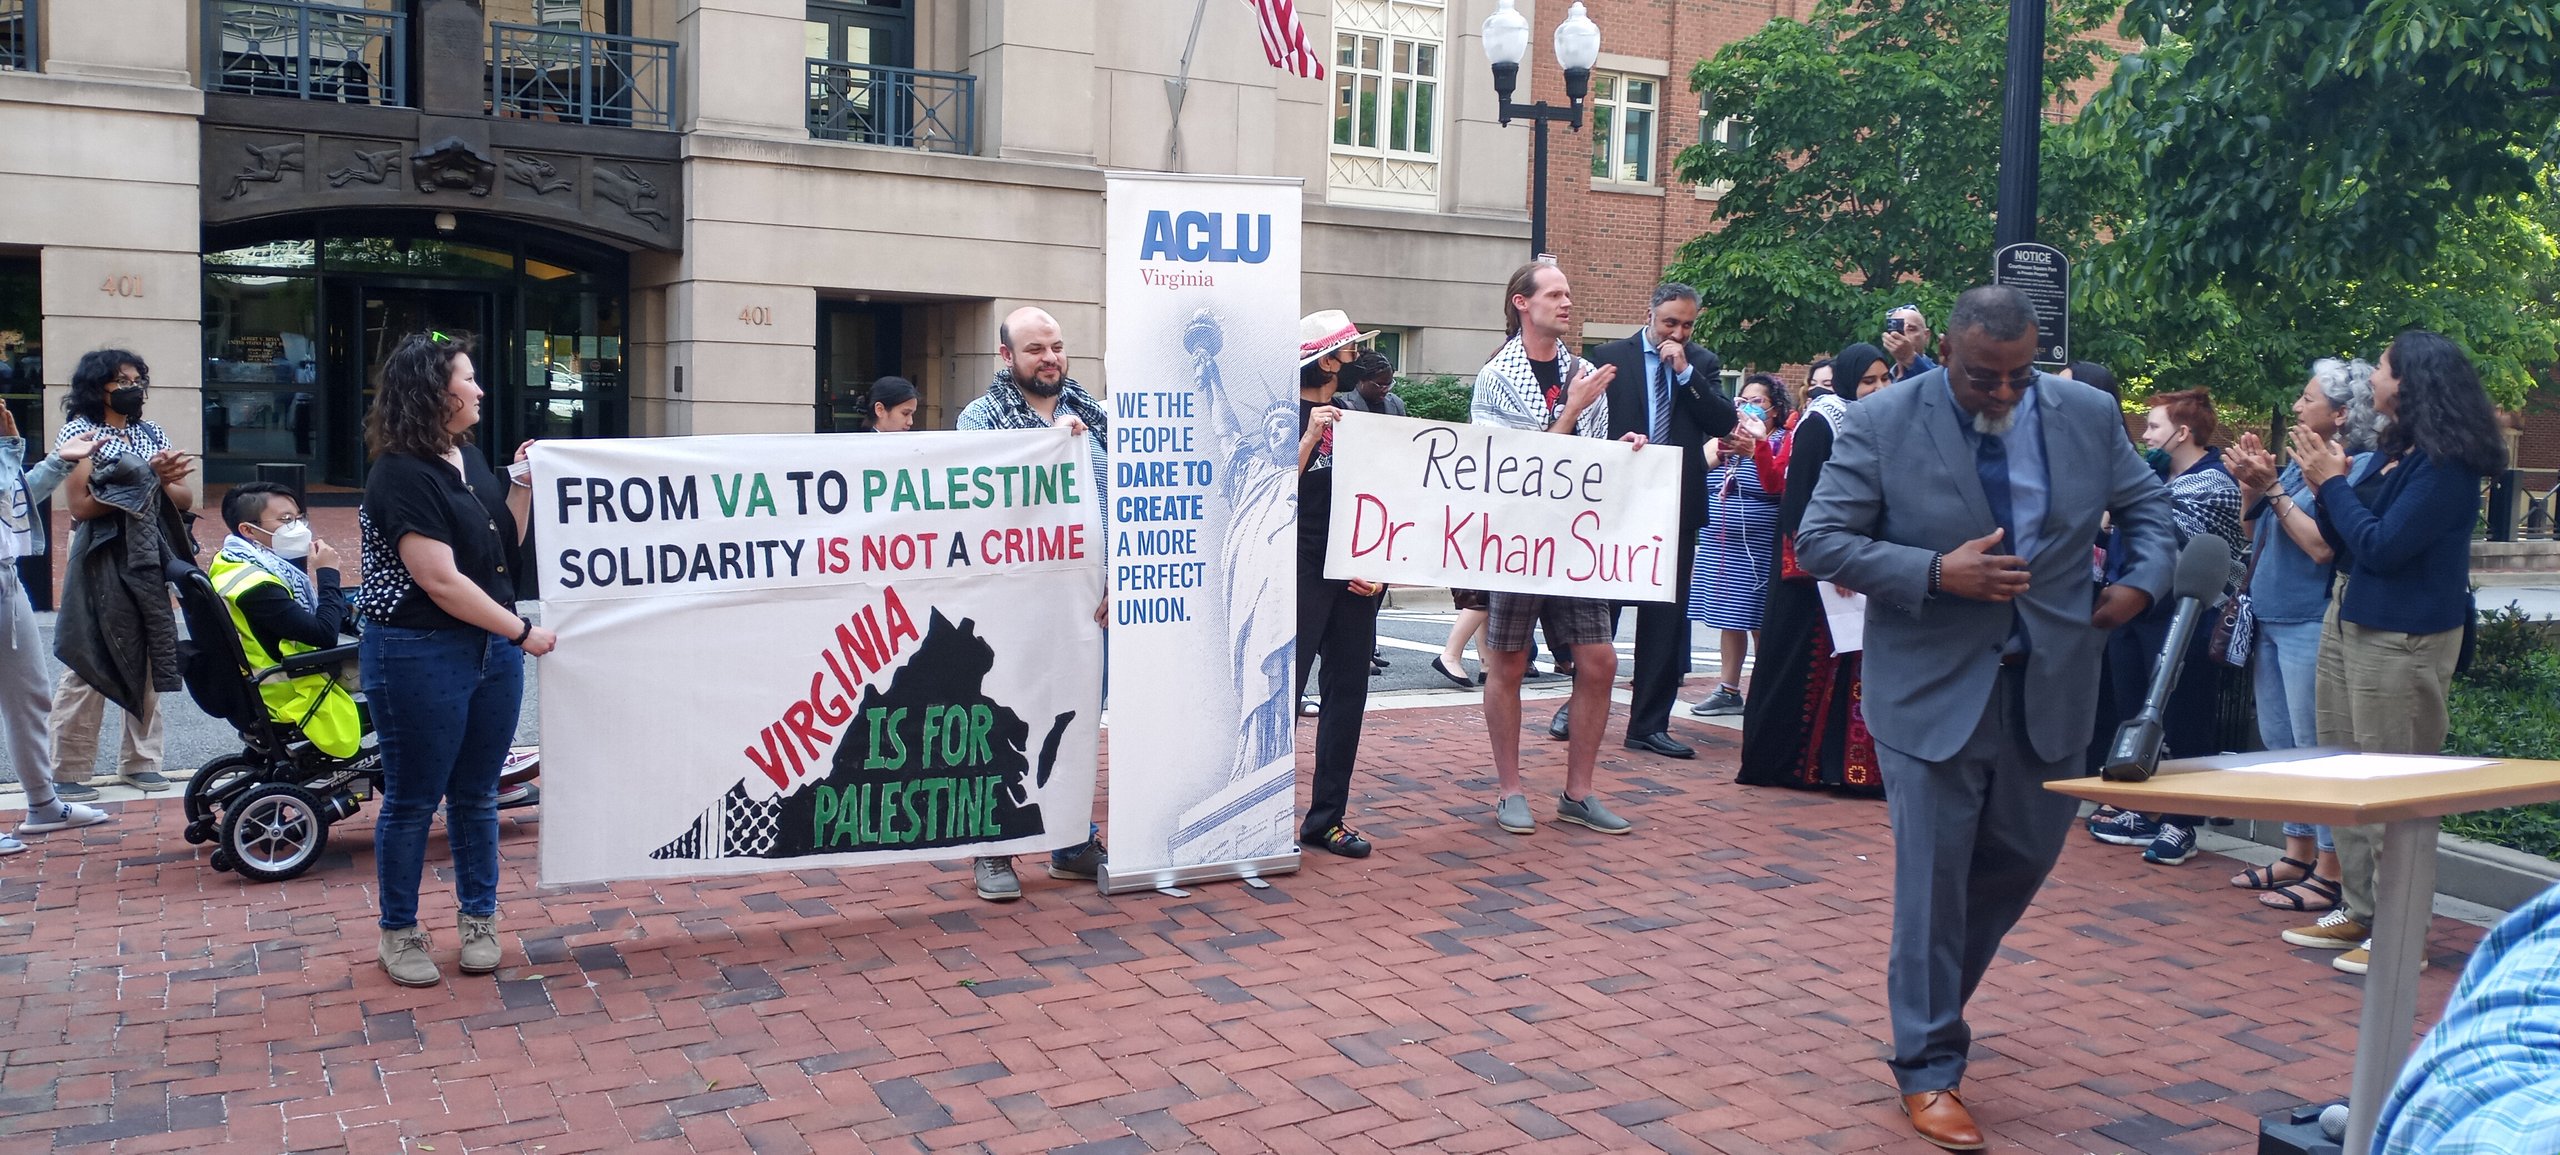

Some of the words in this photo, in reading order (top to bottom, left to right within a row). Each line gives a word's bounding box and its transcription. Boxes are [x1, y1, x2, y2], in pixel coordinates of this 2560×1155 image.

[1140, 210, 1271, 264] ACLU
[2014, 250, 2052, 263] NOTICE
[100, 273, 144, 298] 401
[1140, 268, 1214, 290] Virginia
[738, 305, 772, 326] 401
[1116, 392, 1149, 419] WE
[1153, 392, 1195, 418] THE
[1117, 426, 1194, 453] PEOPLE
[1117, 460, 1178, 488] DARE
[1183, 459, 1213, 487] TO
[1412, 427, 1602, 502] Release
[557, 475, 699, 524] FROM
[711, 472, 778, 518] VA
[786, 470, 848, 515] TO
[863, 462, 1080, 513] PALESTINE
[1116, 495, 1203, 523] CREATE
[1116, 531, 1131, 557] A
[1137, 529, 1197, 556] MORE
[1351, 493, 1415, 562] Dr.
[1443, 505, 1555, 578] Khan
[1566, 510, 1663, 586] Suri
[559, 538, 805, 588] SOLIDARITY
[817, 536, 850, 574] IS
[862, 532, 938, 571] NOT
[946, 531, 971, 567] A
[980, 524, 1084, 564] CRIME
[1117, 562, 1206, 592] PERFECT
[1117, 597, 1191, 626] UNION.
[744, 585, 919, 791] VIRGINIA
[863, 706, 908, 770] IS
[922, 703, 993, 769] FOR
[813, 775, 1002, 849] PALESTINE
